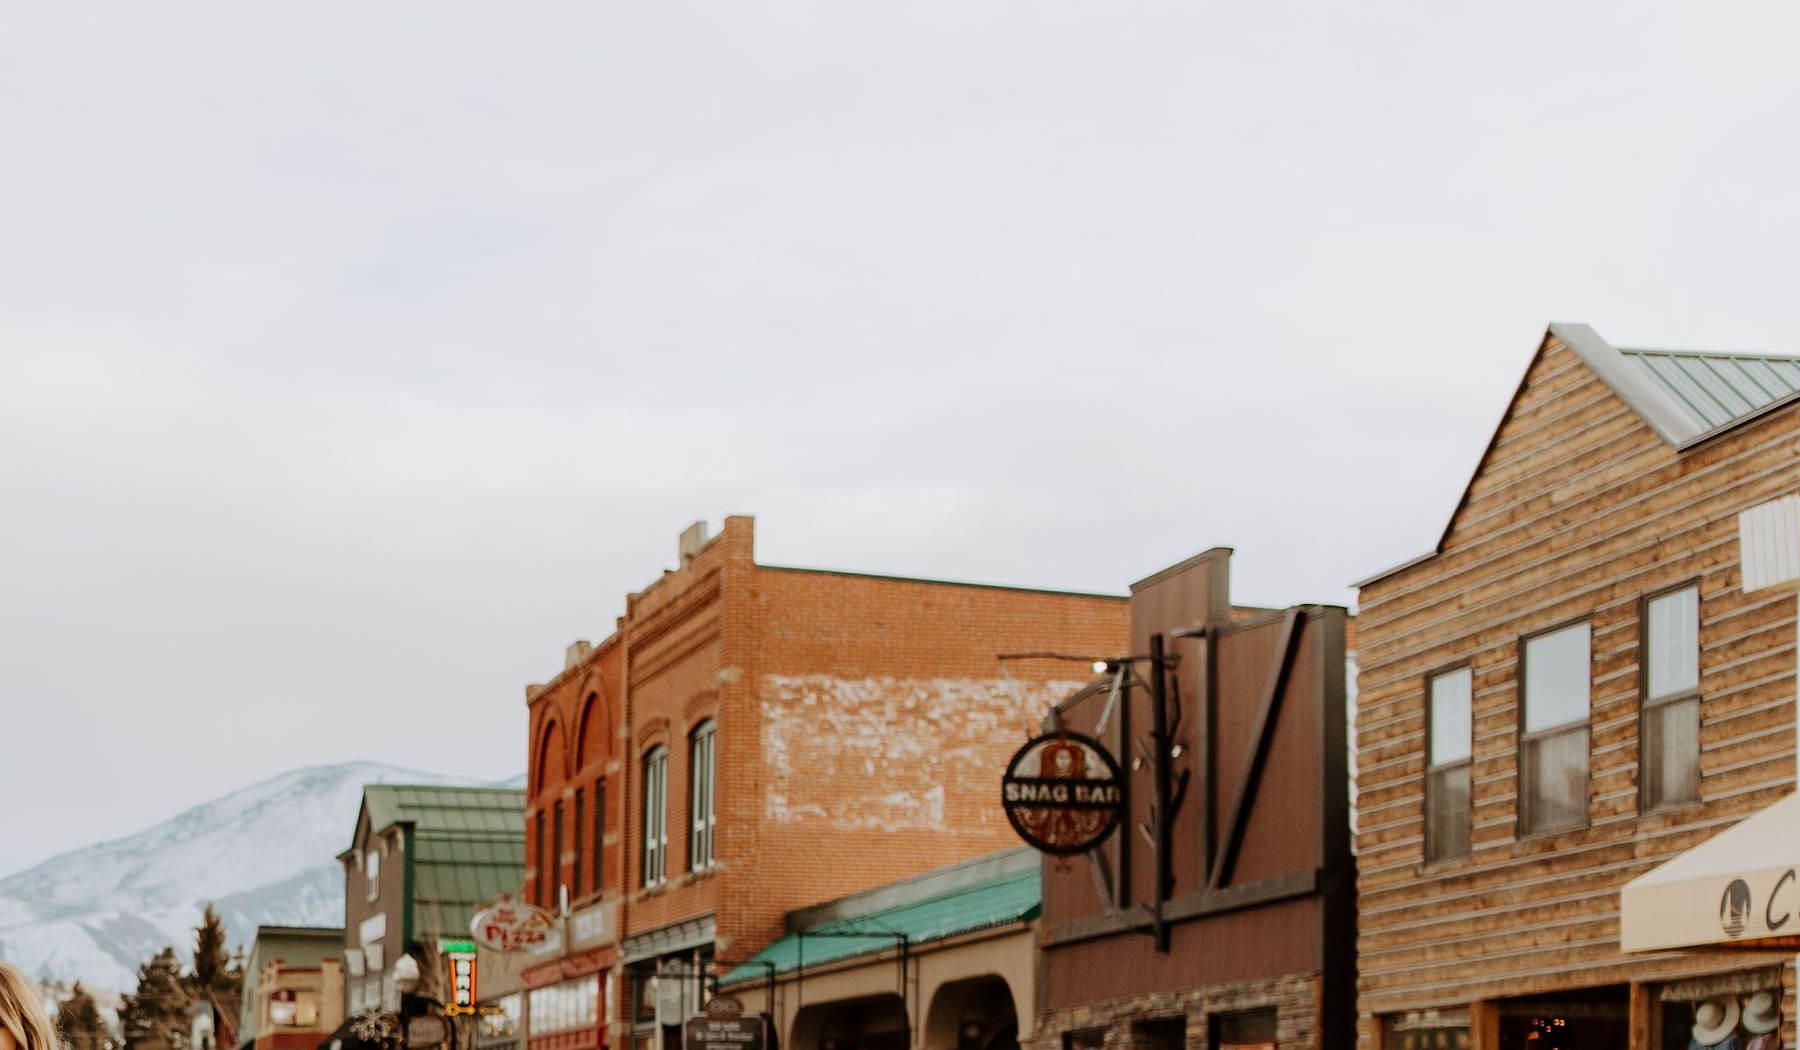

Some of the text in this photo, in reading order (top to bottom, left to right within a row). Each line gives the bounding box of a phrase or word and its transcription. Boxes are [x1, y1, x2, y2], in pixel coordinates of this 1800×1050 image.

[1006, 782, 1068, 802] SNAG
[1766, 868, 1800, 931] C
[486, 925, 546, 945] Pizza
